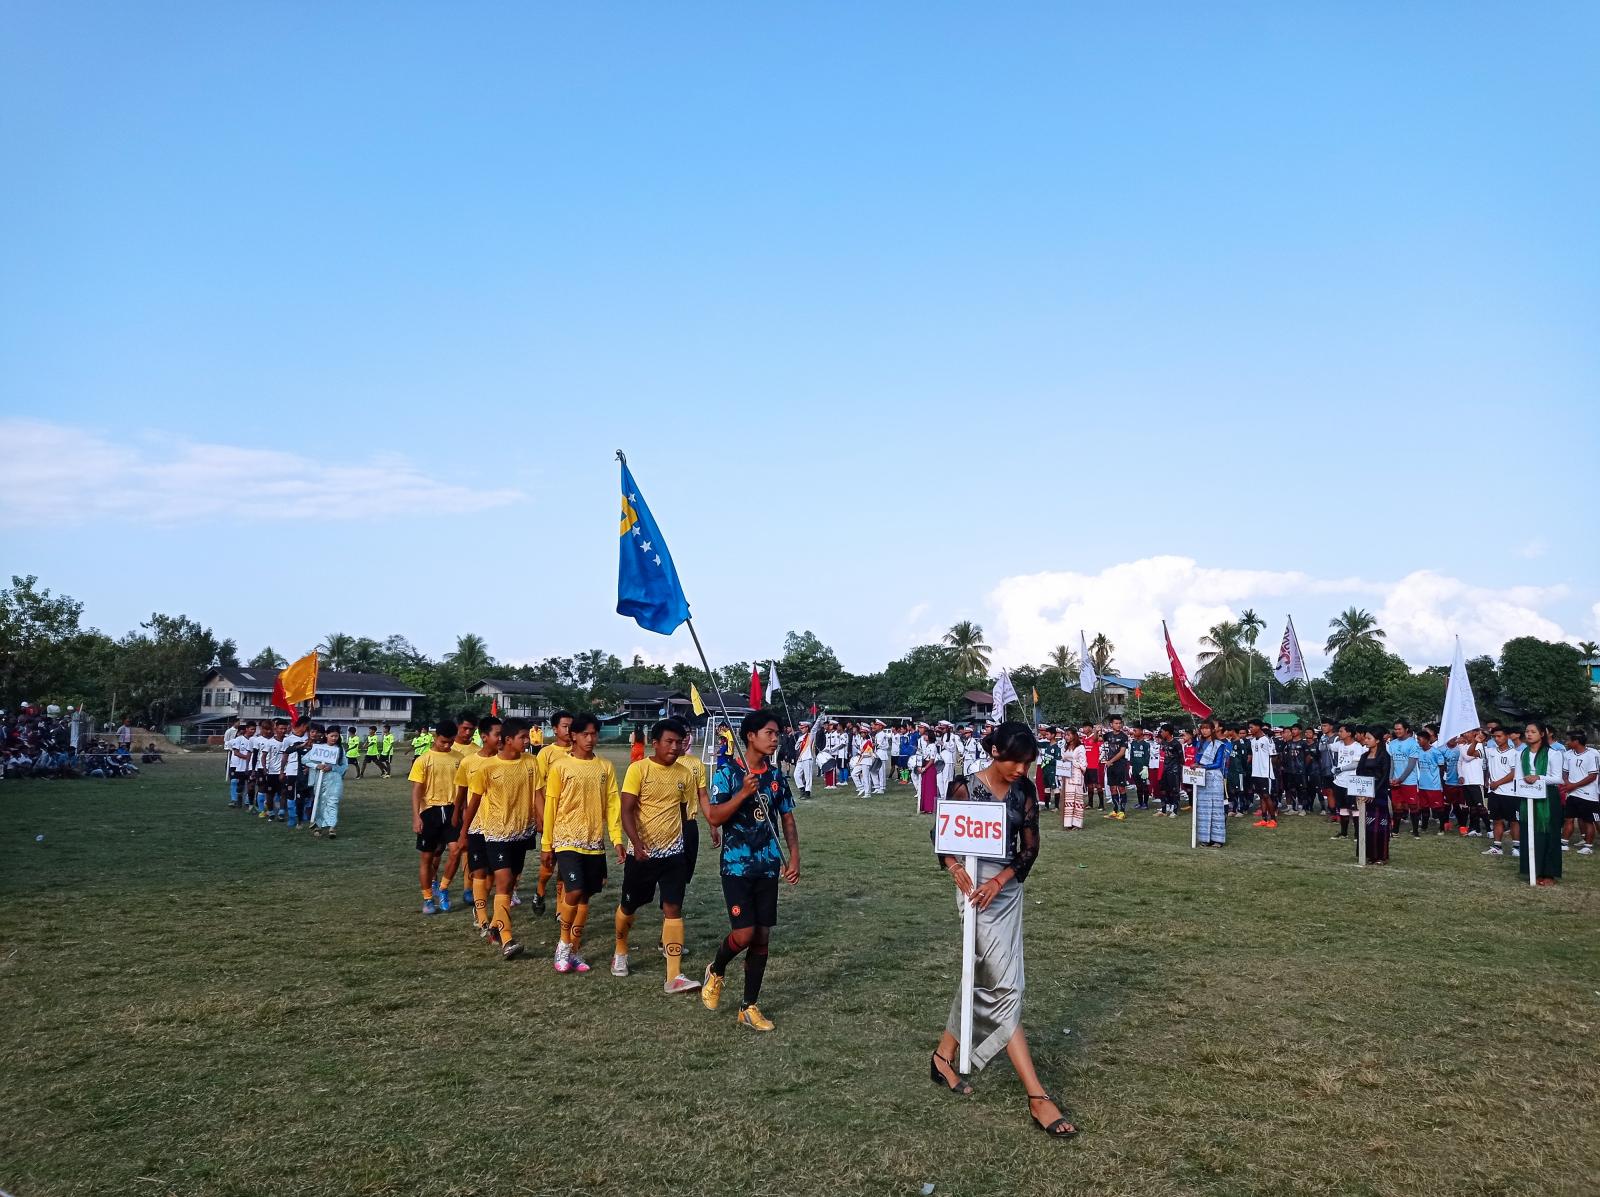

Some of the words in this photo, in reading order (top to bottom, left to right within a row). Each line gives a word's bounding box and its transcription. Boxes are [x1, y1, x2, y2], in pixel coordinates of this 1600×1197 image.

[312, 748, 337, 759] ATOM
[1500, 756, 1508, 765] 10
[940, 814, 950, 836] 7
[954, 814, 1002, 840] Stars
